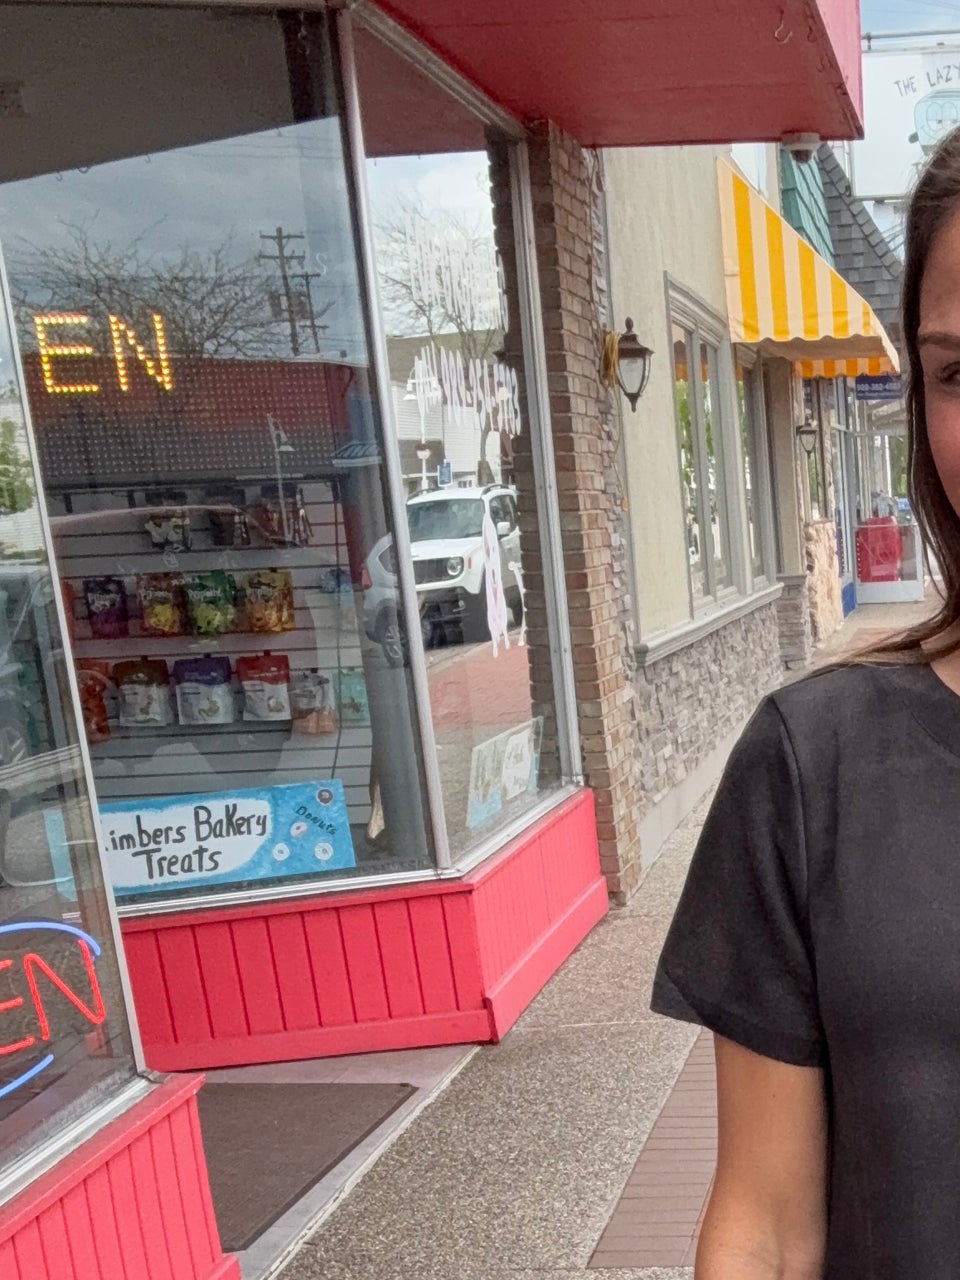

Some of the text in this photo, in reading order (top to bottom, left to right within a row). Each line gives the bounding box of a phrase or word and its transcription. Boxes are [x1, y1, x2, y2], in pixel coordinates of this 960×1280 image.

[894, 75, 917, 97] THE
[105, 815, 187, 852] imbers
[131, 845, 222, 880] Treats
